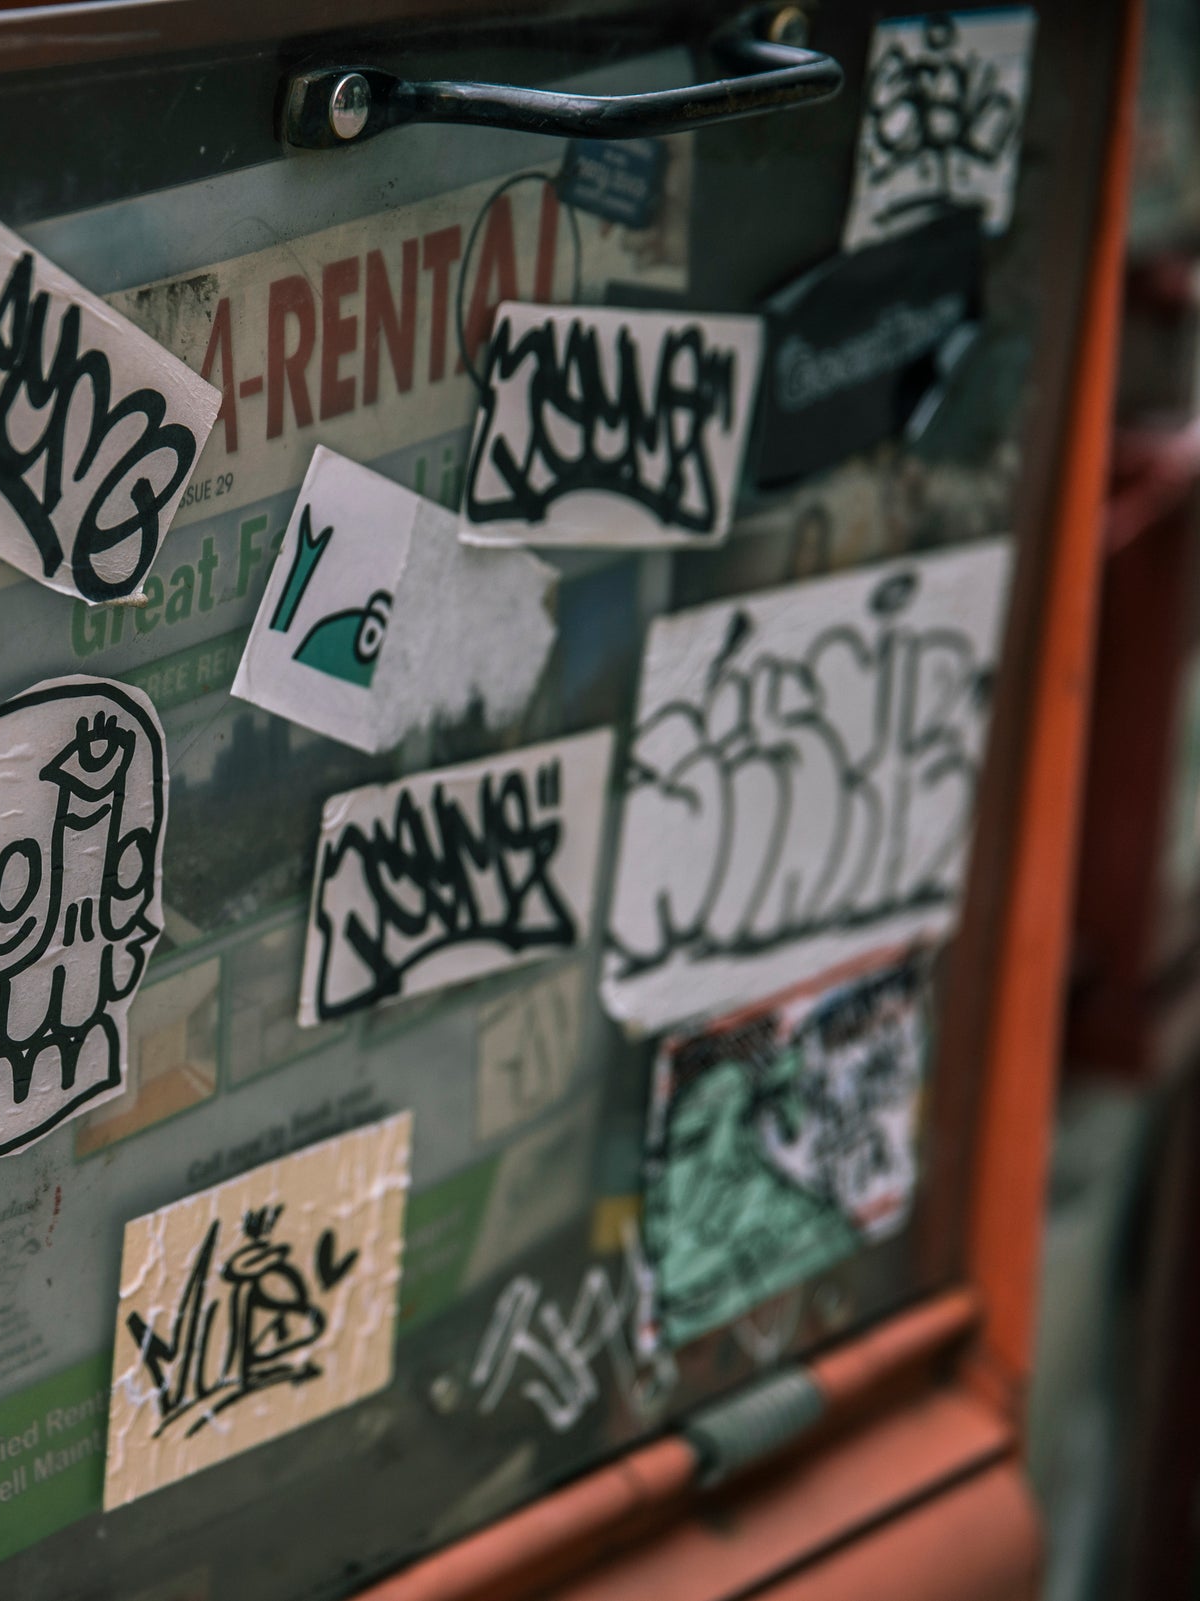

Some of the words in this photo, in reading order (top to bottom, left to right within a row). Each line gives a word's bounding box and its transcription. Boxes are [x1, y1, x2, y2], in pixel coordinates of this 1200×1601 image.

[178, 478, 213, 509] SSUE
[215, 471, 235, 497] 29
[45, 1390, 106, 1438] Rent
[33, 1428, 101, 1484] Maint
